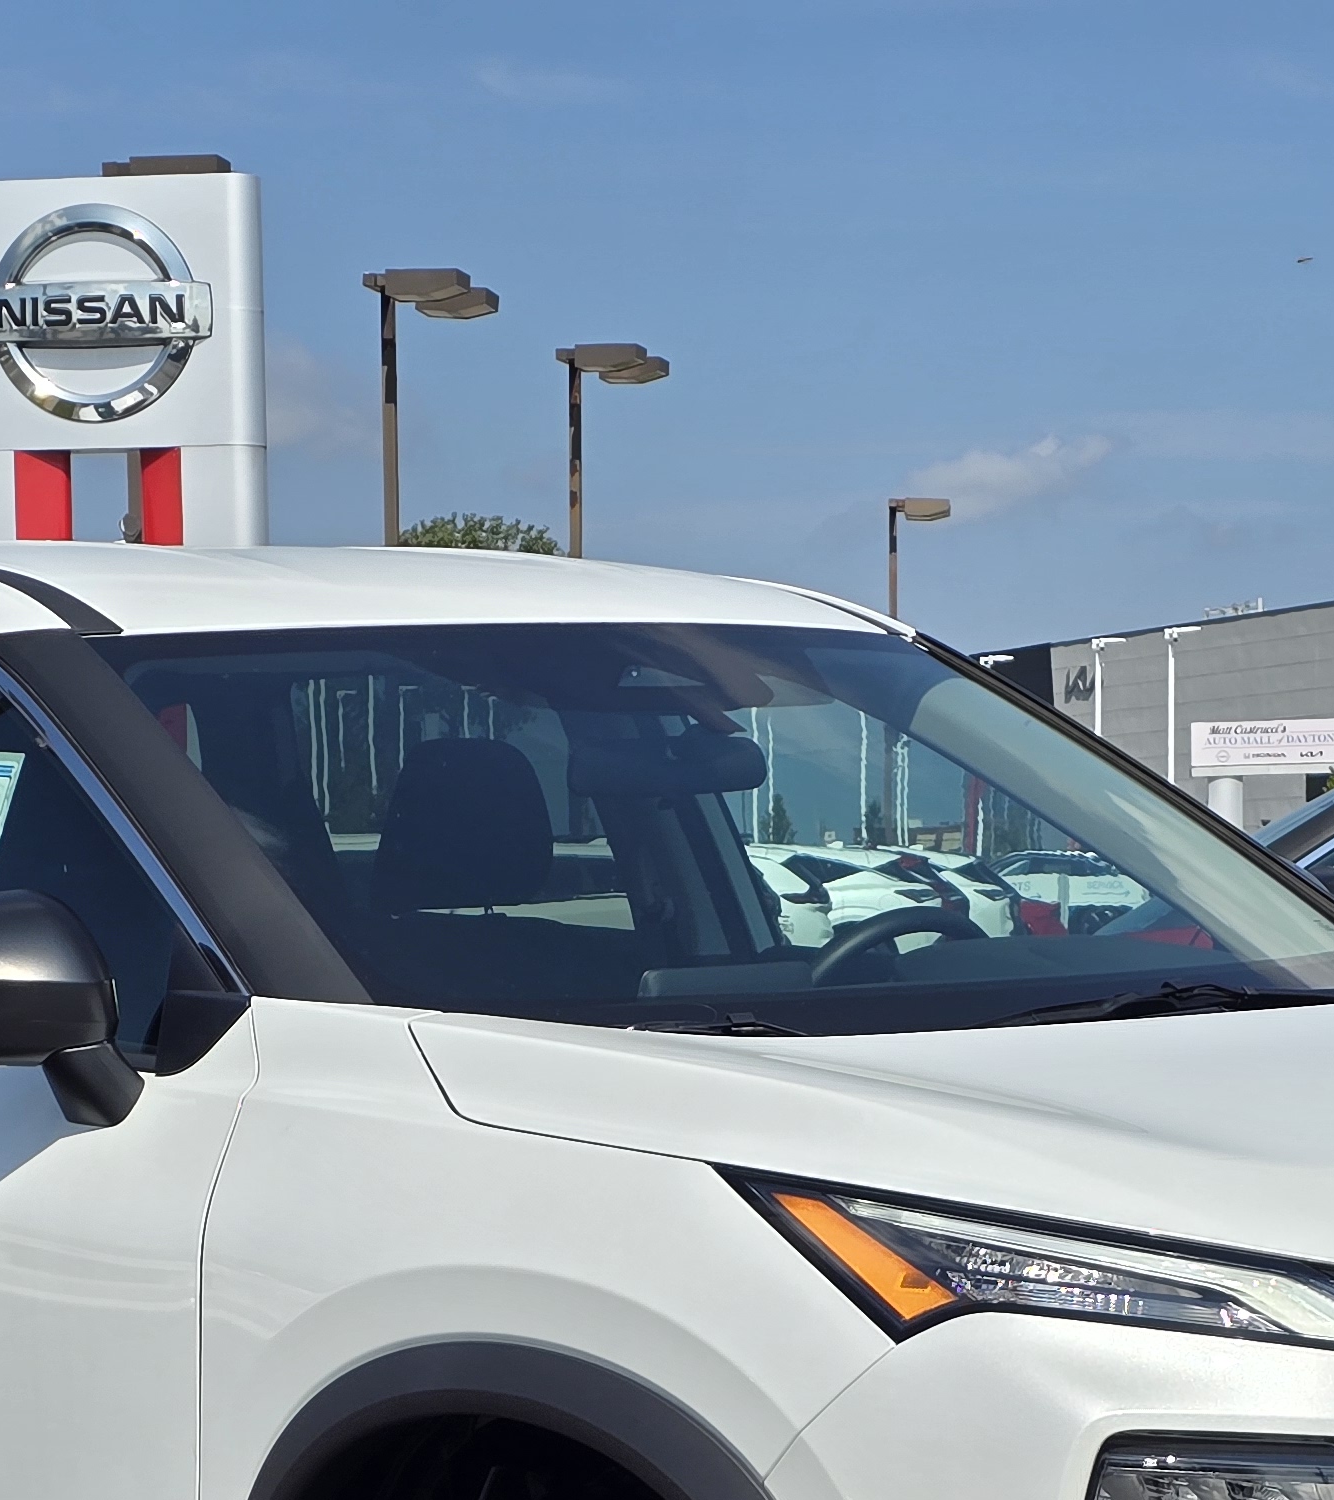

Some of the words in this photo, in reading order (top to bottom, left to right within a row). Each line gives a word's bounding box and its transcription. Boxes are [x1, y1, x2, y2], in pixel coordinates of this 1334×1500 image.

[1208, 725, 1233, 735] Matt
[1234, 723, 1287, 735] Castrucci's
[1204, 736, 1238, 746] AUTO
[1240, 735, 1275, 745] MALL
[1286, 733, 1334, 744] DAYTON
